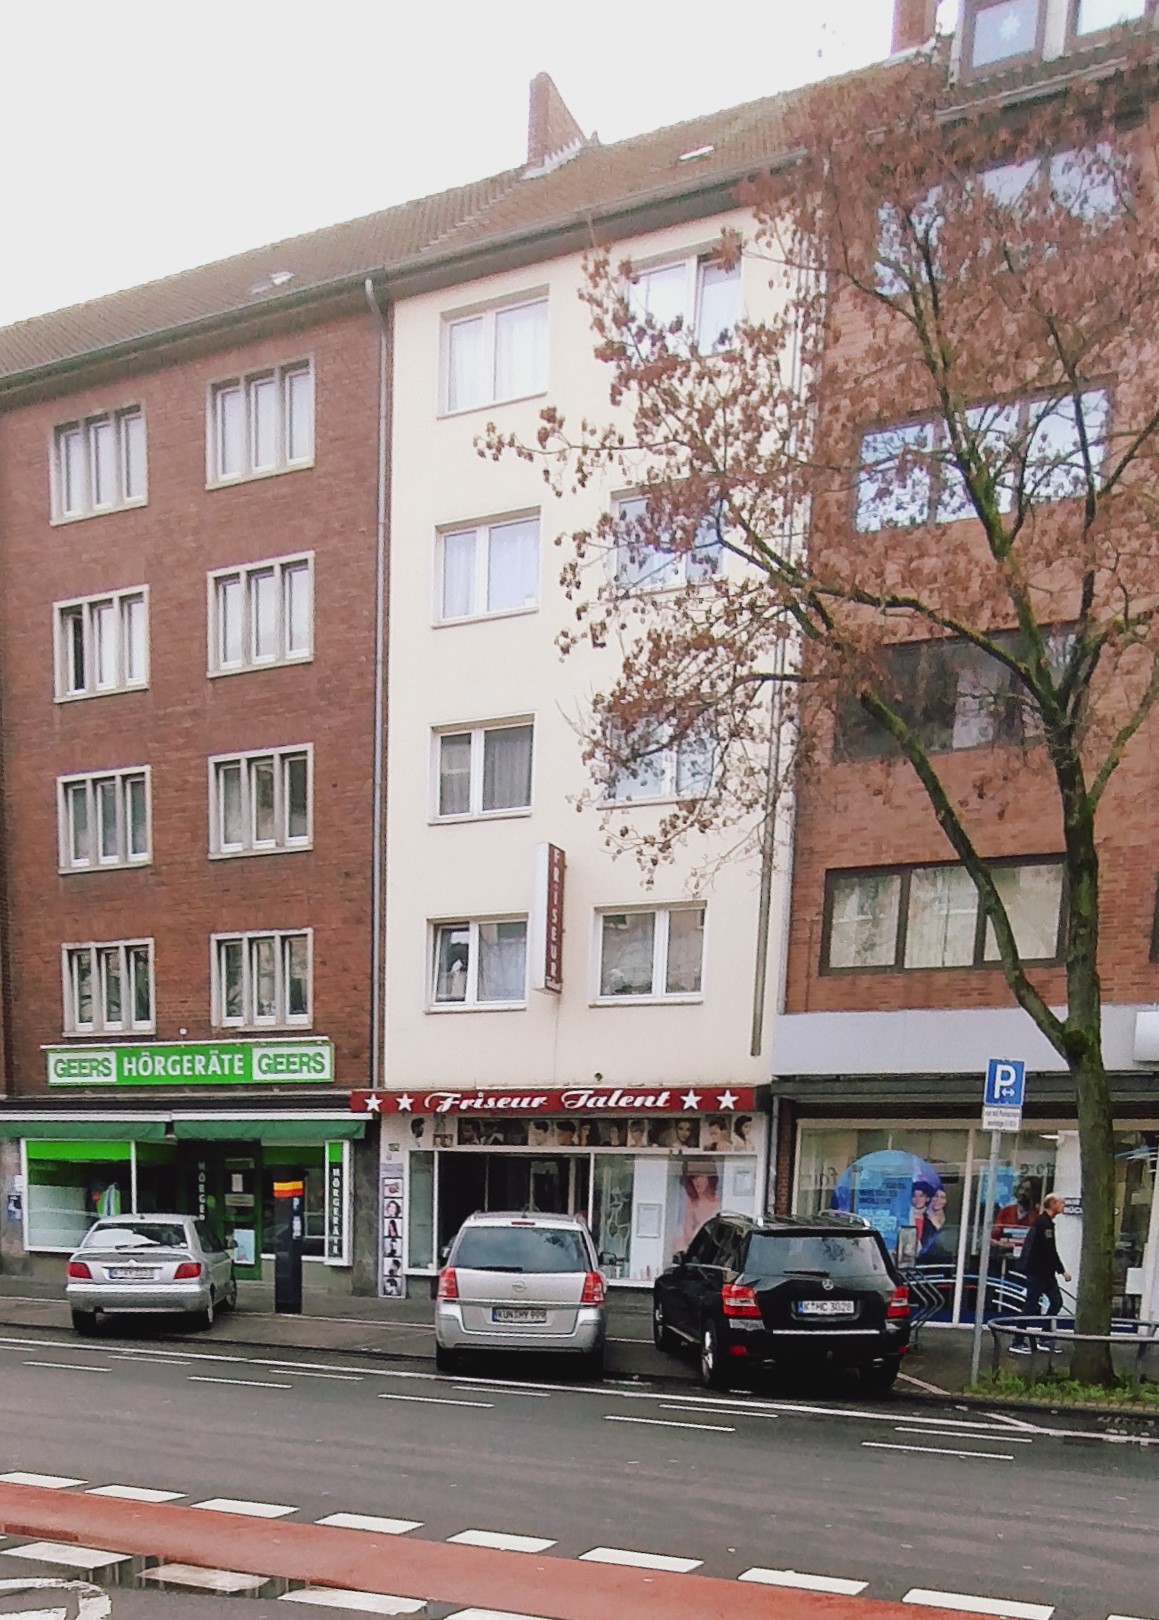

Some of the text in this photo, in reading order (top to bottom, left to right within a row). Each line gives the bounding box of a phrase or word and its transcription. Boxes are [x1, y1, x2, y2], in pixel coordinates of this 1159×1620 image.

[549, 848, 560, 978] FRISEUR
[54, 1050, 326, 1079] GEERS HÖRGERÄTE GEERS
[993, 1064, 1017, 1099] P
[424, 1089, 671, 1113] Friseur Talent
